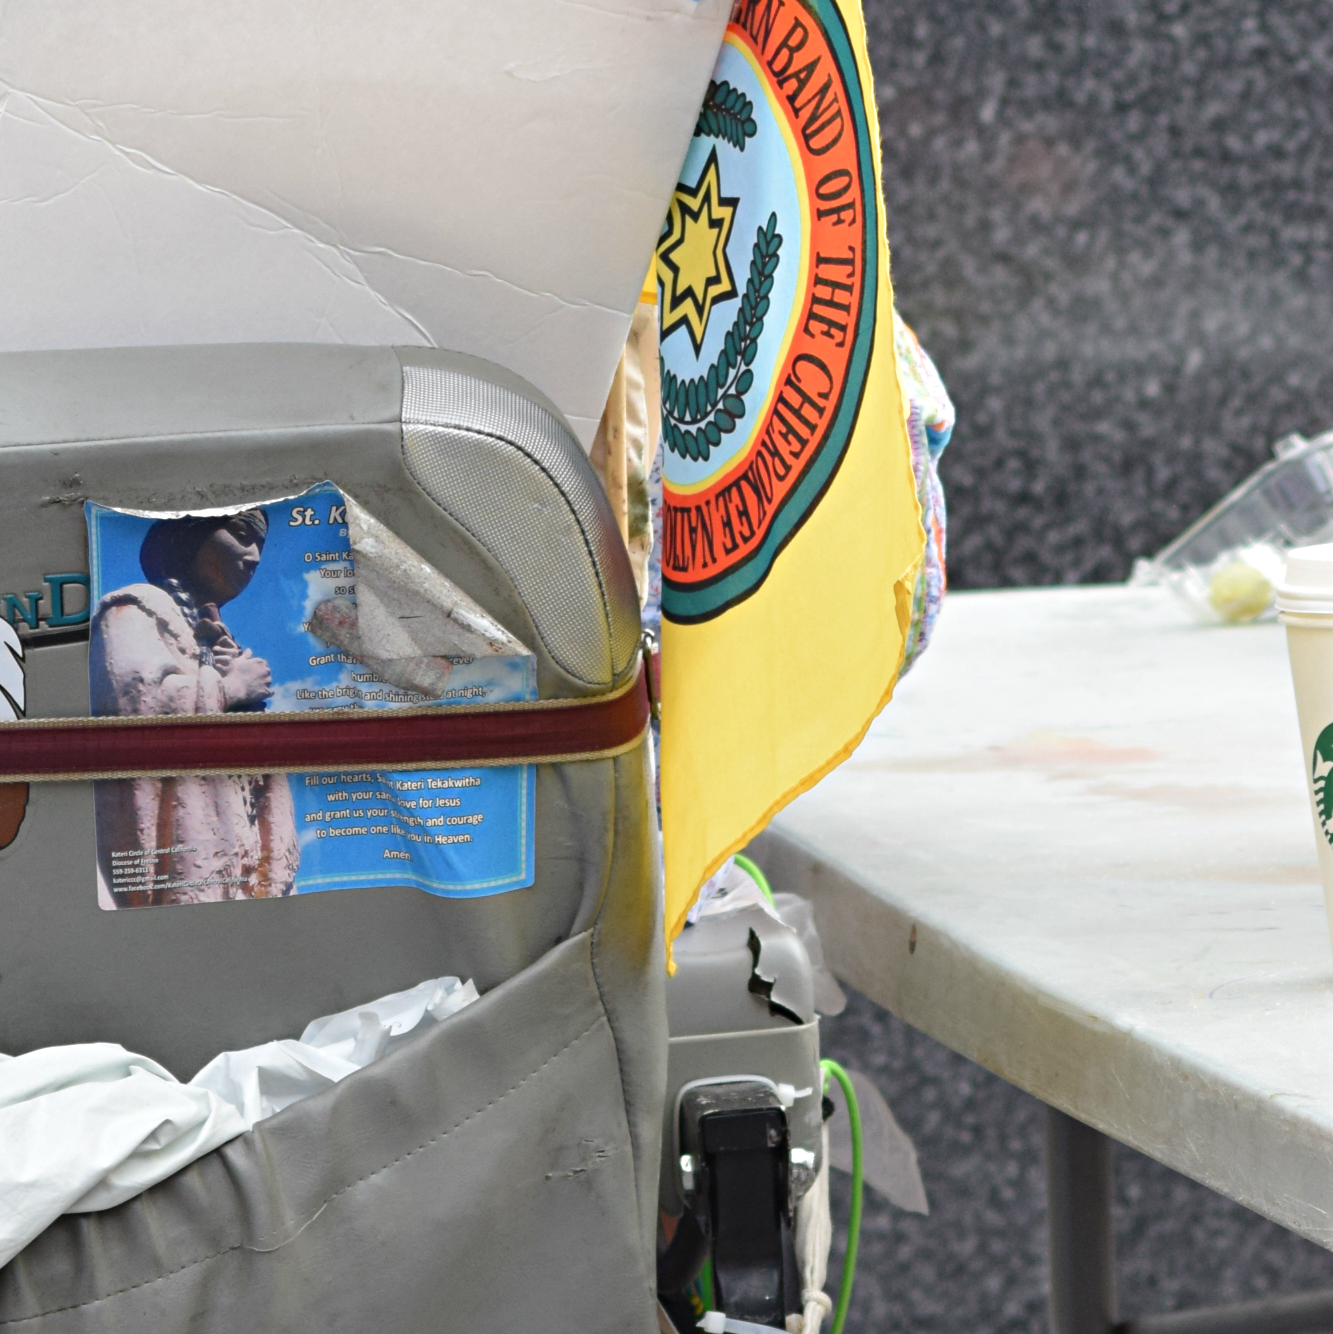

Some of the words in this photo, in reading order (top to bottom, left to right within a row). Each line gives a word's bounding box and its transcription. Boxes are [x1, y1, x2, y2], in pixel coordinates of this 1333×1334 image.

[767, 16, 845, 156] BAND
[815, 168, 857, 227] OF
[803, 245, 856, 348] THE
[715, 353, 834, 556] CHEROKEE
[289, 507, 320, 526] St.
[316, 552, 339, 562] Saint
[320, 569, 342, 578] Your
[309, 654, 334, 665] Grant
[297, 689, 316, 699] Like
[318, 690, 334, 699] the
[365, 691, 382, 700] and
[385, 692, 419, 703] shining
[458, 687, 486, 697] night,
[305, 776, 319, 786] Fill
[322, 775, 338, 784] our
[341, 773, 374, 783] hearts,
[396, 780, 425, 790] Kateri
[427, 776, 481, 788] Tekakwitha
[327, 792, 348, 801] with
[351, 792, 373, 801] your
[419, 798, 432, 807] for
[435, 797, 461, 807] Jesus
[305, 812, 322, 822] and
[326, 810, 350, 820] grant
[353, 809, 364, 817] us
[367, 809, 388, 819] your
[426, 816, 444, 826] and
[446, 814, 483, 825] courage
[317, 829, 327, 838] to
[329, 827, 367, 836] become
[370, 826, 389, 834] one
[391, 824, 405, 836] like
[424, 835, 432, 843] in
[435, 835, 473, 845] Heaven.
[383, 849, 413, 862] Amen.
